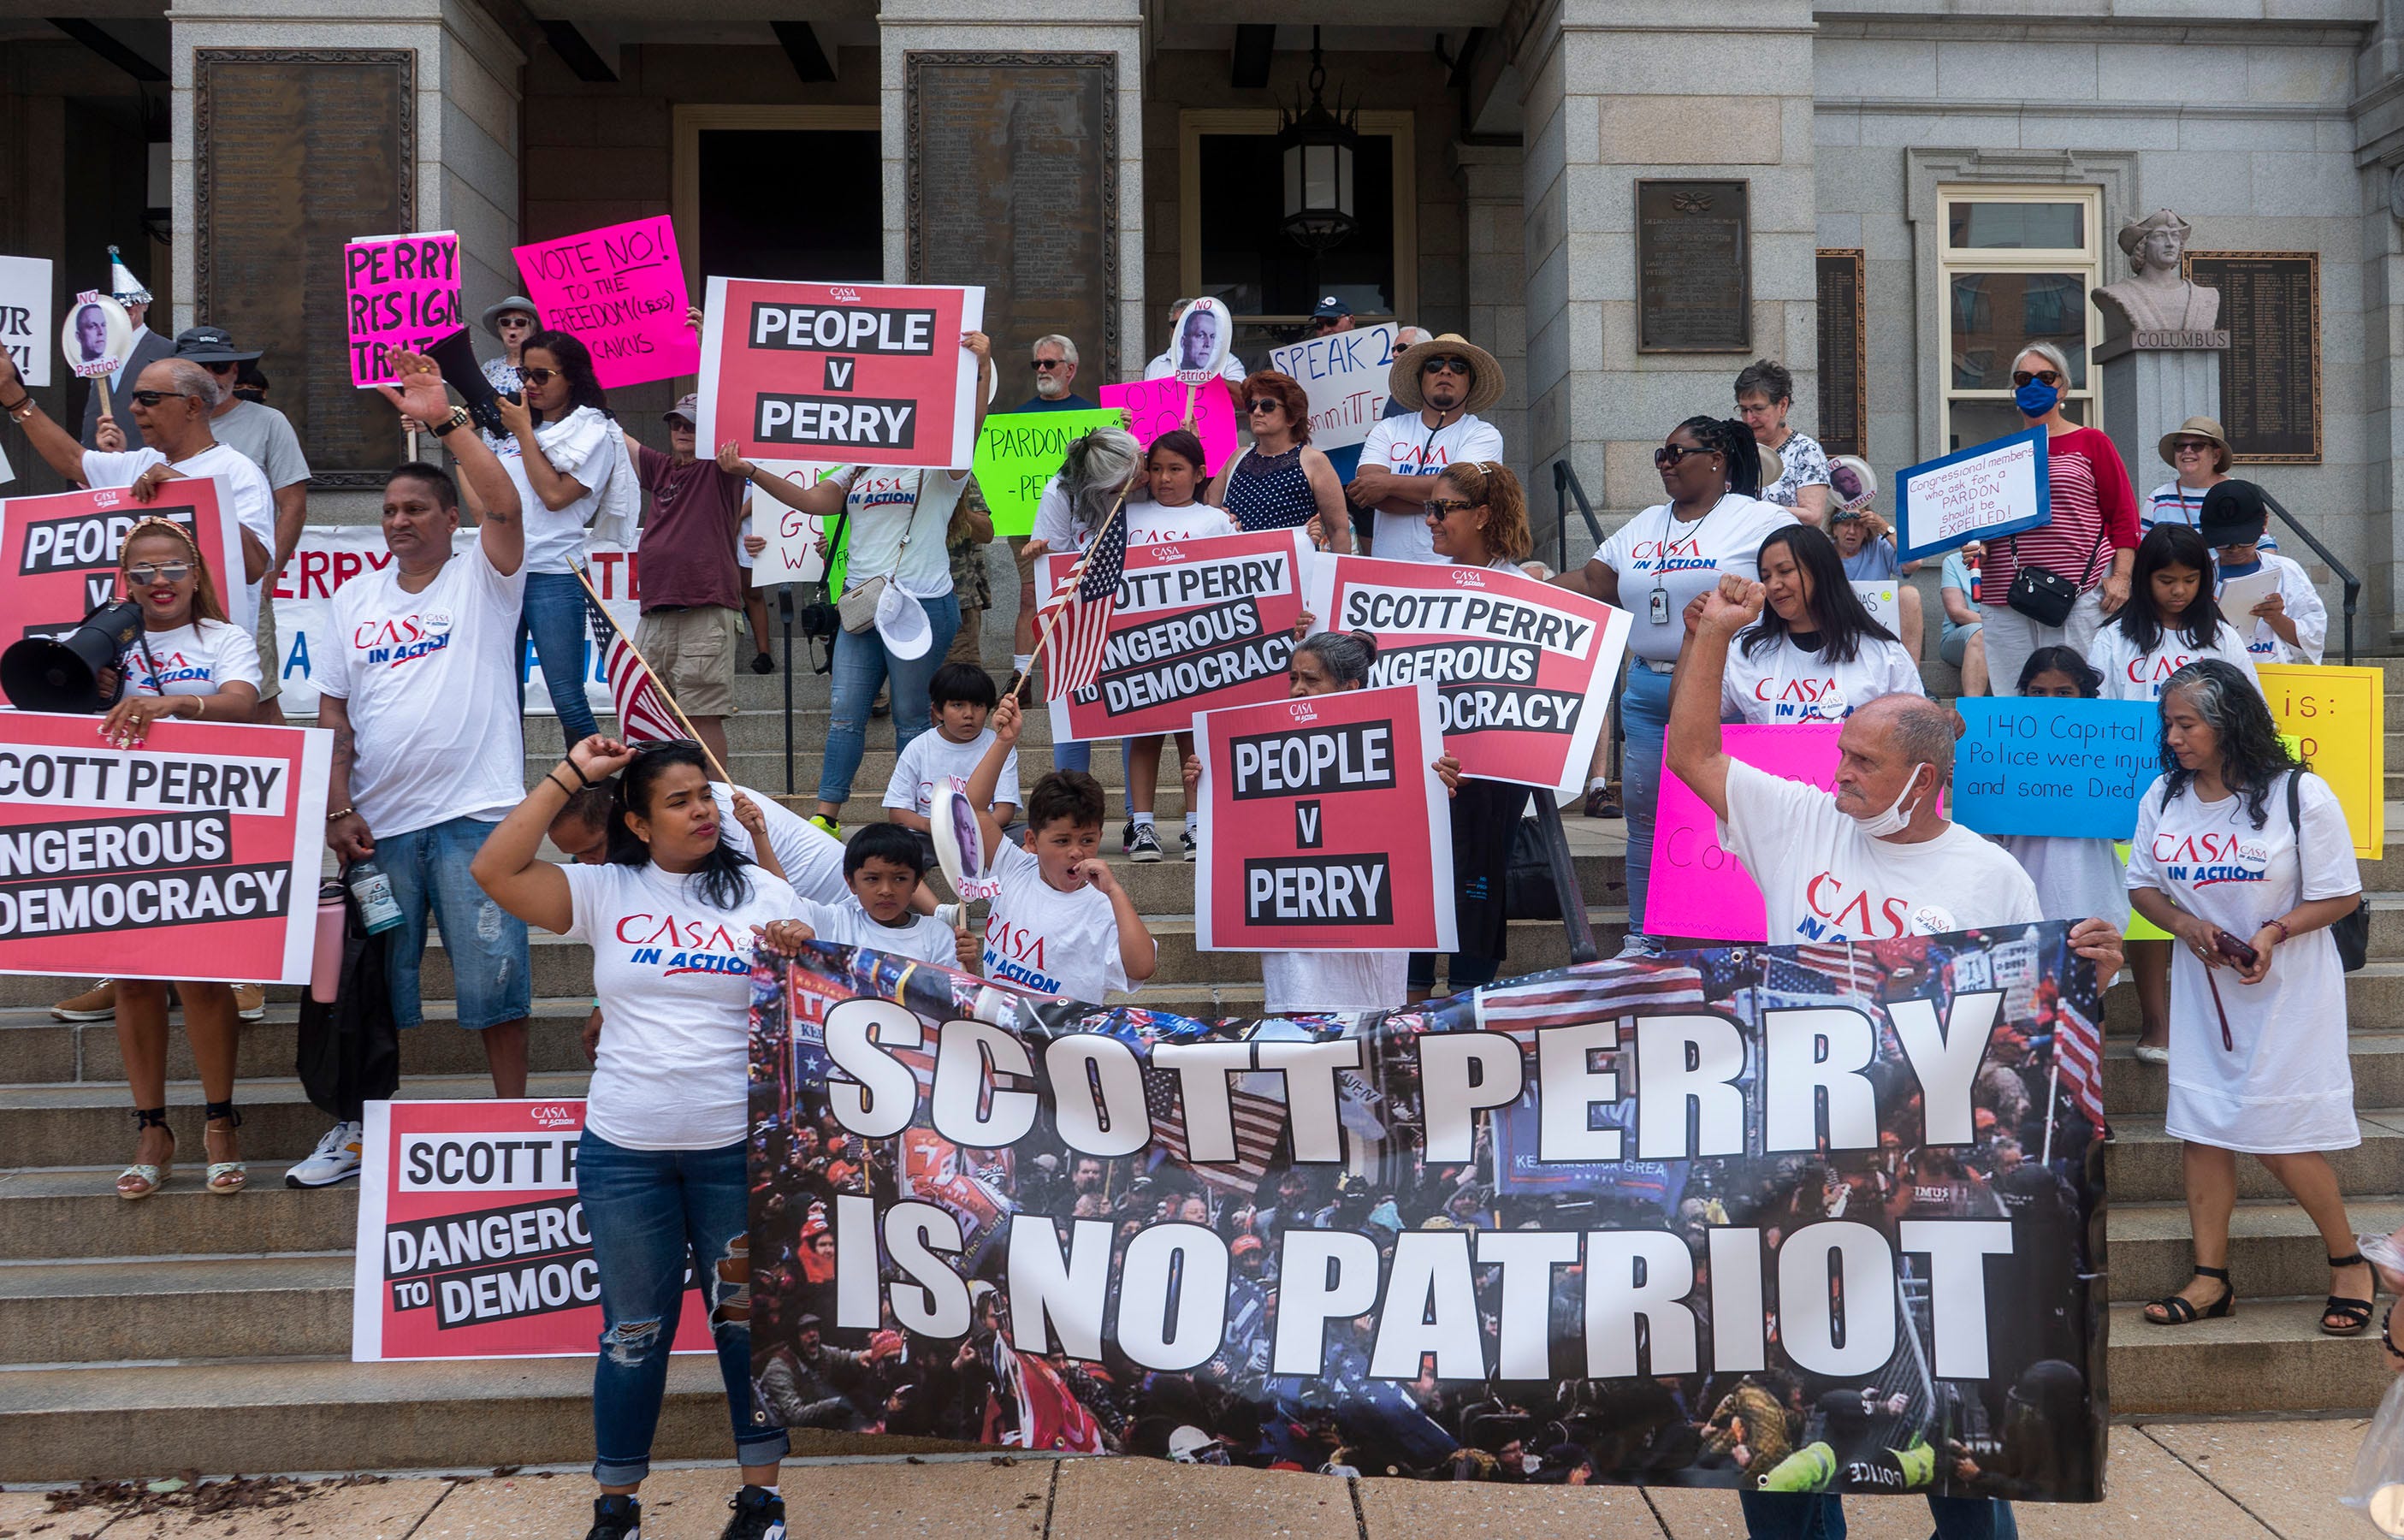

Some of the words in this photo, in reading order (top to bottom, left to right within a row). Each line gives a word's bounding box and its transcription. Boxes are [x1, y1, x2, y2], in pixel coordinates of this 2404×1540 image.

[347, 242, 456, 289] PERRY
[529, 242, 601, 281] VOTE
[604, 225, 670, 270] NO!
[79, 291, 98, 305] NO
[563, 285, 589, 302] TO
[595, 277, 630, 295] THE
[830, 287, 856, 296] CASA
[352, 288, 463, 335] RESIGN
[1194, 299, 1212, 311] NO
[756, 307, 932, 351] PEOPLE
[2137, 332, 2226, 347] COLUMBUS
[1275, 335, 1366, 380] SPEAK
[1371, 328, 1394, 366] 2
[76, 358, 119, 376] Patriot
[1175, 370, 1211, 381] Patriot
[761, 400, 912, 443] PERRY
[1399, 465, 1413, 474] IN
[1910, 459, 1986, 493] Congressional
[1988, 447, 2034, 467] members
[850, 477, 903, 493] ASA
[1925, 489, 1944, 500] who
[1948, 479, 1965, 493] ask
[1972, 474, 1990, 485] for
[1998, 470, 2005, 479] a
[1942, 482, 1999, 509] PARDON
[849, 494, 860, 505] IN
[864, 492, 916, 506] ACTION
[1844, 490, 1875, 511] Patriot
[1942, 503, 1975, 524] should
[1981, 500, 1995, 511] be
[1152, 546, 1180, 556] CASA
[1631, 539, 1702, 559] CASA
[1452, 570, 1481, 582] CASA
[1632, 560, 1652, 569] IN
[1655, 559, 1717, 570] ACTION
[1178, 558, 1283, 601] PERRY
[354, 615, 426, 649] CAS
[1347, 590, 1462, 628] SCOTT
[1461, 597, 1590, 651] PERRY
[124, 652, 192, 674] ASA
[369, 648, 390, 664] IN
[1075, 685, 1098, 703] TO
[1289, 702, 1313, 716] CASA
[1776, 703, 1794, 716] IN
[1988, 714, 2037, 738] 140
[2051, 715, 2143, 749] Capital
[1235, 728, 1390, 792] PEOPLE
[1970, 742, 2039, 766] Police
[2048, 752, 2105, 768] were
[127, 760, 281, 808] PERRY
[1968, 774, 2005, 795] and
[2018, 781, 2073, 797] some
[2088, 777, 2135, 799] Died
[2152, 833, 2238, 862] CASA
[2240, 845, 2267, 858] CASA
[2168, 867, 2187, 880] IN
[2194, 866, 2265, 880] ACTION
[958, 877, 1002, 898] Patriot
[1250, 864, 1384, 917] PERRY
[1807, 871, 1915, 939] CAS
[616, 914, 735, 951] CASA
[1797, 915, 1826, 940] IN
[1920, 909, 1950, 933] CASA
[985, 912, 1046, 971] CASA
[631, 949, 662, 964] IN
[983, 948, 997, 966] IN
[996, 959, 1061, 994] ACTION
[823, 996, 1364, 1165] SCOTT
[1418, 988, 2008, 1164] PERRY
[531, 1106, 568, 1119] CASA
[548, 1118, 576, 1128] ACTION
[407, 1140, 552, 1186] SCOTT
[395, 1281, 429, 1308] TO
[836, 1194, 972, 1339] IS
[1007, 1211, 1230, 1371] NO
[1271, 1217, 2014, 1381] PATRIOT
